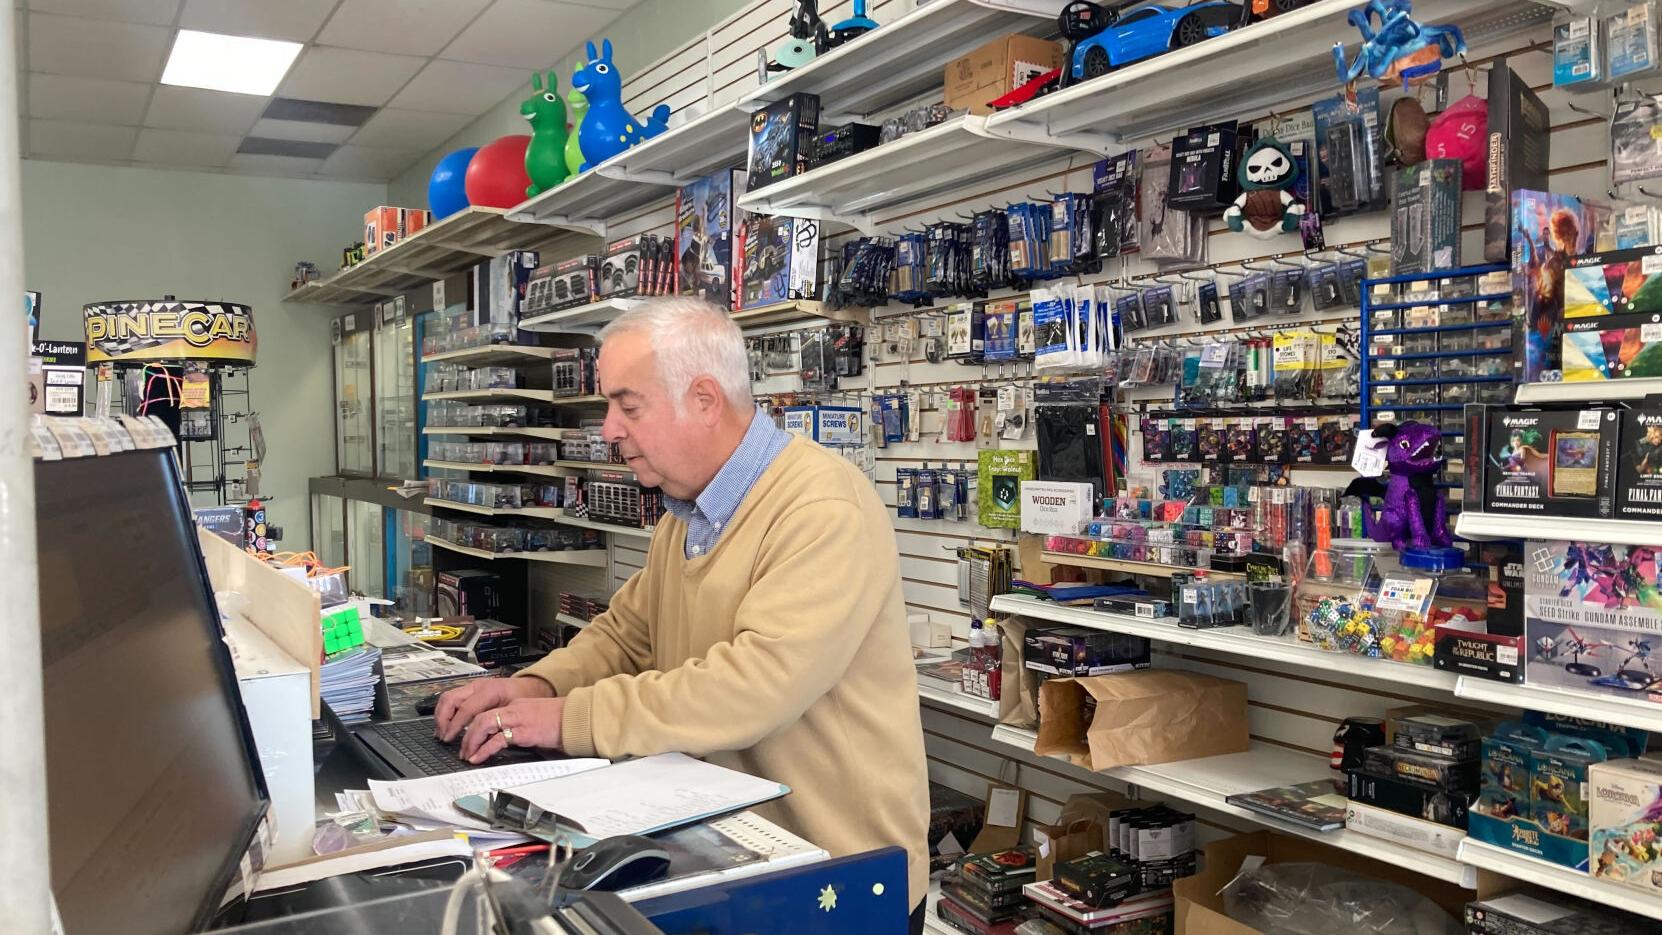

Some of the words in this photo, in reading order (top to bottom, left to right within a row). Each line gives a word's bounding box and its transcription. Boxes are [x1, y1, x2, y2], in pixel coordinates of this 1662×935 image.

[1456, 122, 1477, 140] 15
[1487, 132, 1502, 194] PATHFINDER
[1577, 256, 1603, 266] MAGIC
[88, 311, 251, 348] PINECAR
[1573, 322, 1600, 333] MAGIC
[822, 412, 846, 420] MINIATURE
[1510, 418, 1539, 426] MAGIC
[822, 420, 847, 429] SCREWS
[1496, 484, 1513, 497] FINAL
[1513, 485, 1540, 499] FANTASY
[1628, 488, 1648, 502] FINAL
[1032, 495, 1066, 506] WOODEN
[1528, 502, 1545, 510] DECK
[195, 514, 231, 524] ANGERS
[1532, 573, 1559, 585] GUNDAM
[1539, 605, 1556, 618] SEED
[1557, 606, 1580, 621] Strike
[1584, 611, 1617, 625] GUNDAM
[1618, 614, 1658, 630] ASSEMBLE
[1457, 639, 1489, 652] TWILIGHT
[1460, 648, 1494, 662] REPUBLIC
